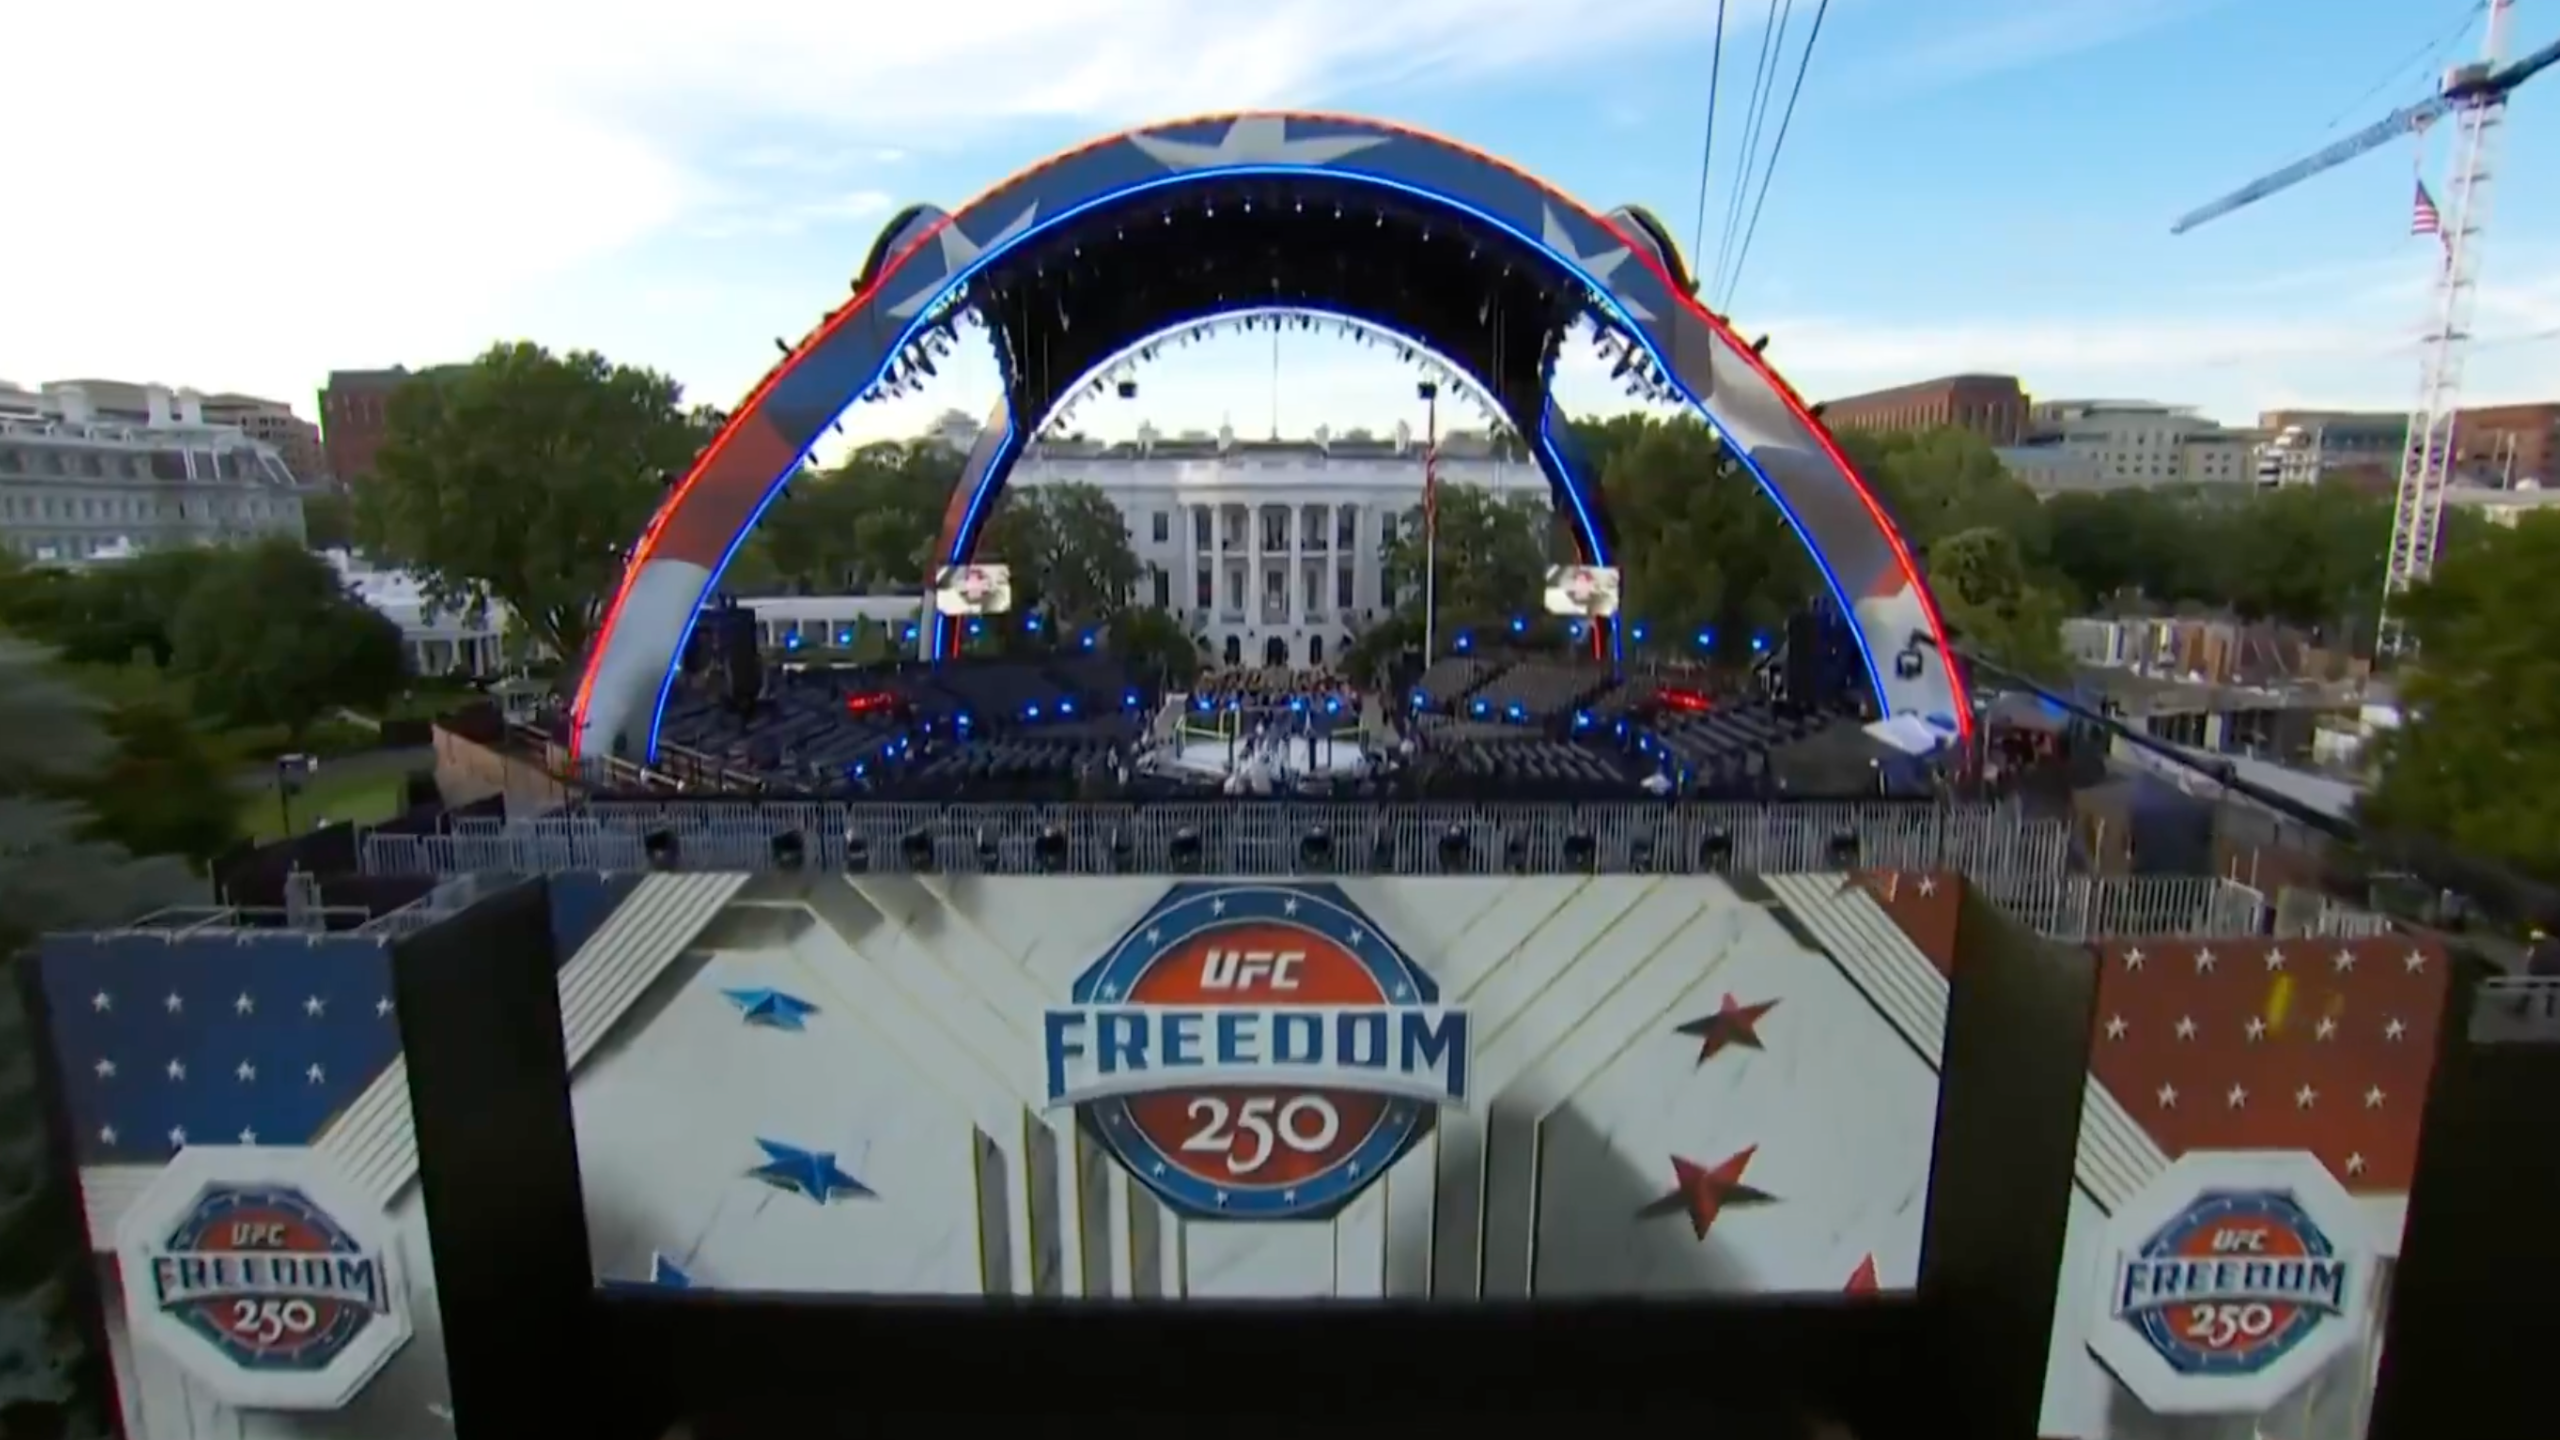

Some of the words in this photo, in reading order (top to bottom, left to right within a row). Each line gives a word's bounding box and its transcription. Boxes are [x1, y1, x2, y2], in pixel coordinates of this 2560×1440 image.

[1201, 950, 1305, 990] UFC
[1045, 1011, 1466, 1100] FREEDOM
[1181, 1097, 1339, 1174] 250
[231, 1223, 285, 1247] UFC
[2212, 1228, 2268, 1251] UFC
[2122, 1262, 2345, 1307] FREEDOM
[234, 1300, 315, 1344] 250
[2187, 1303, 2273, 1347] 250
